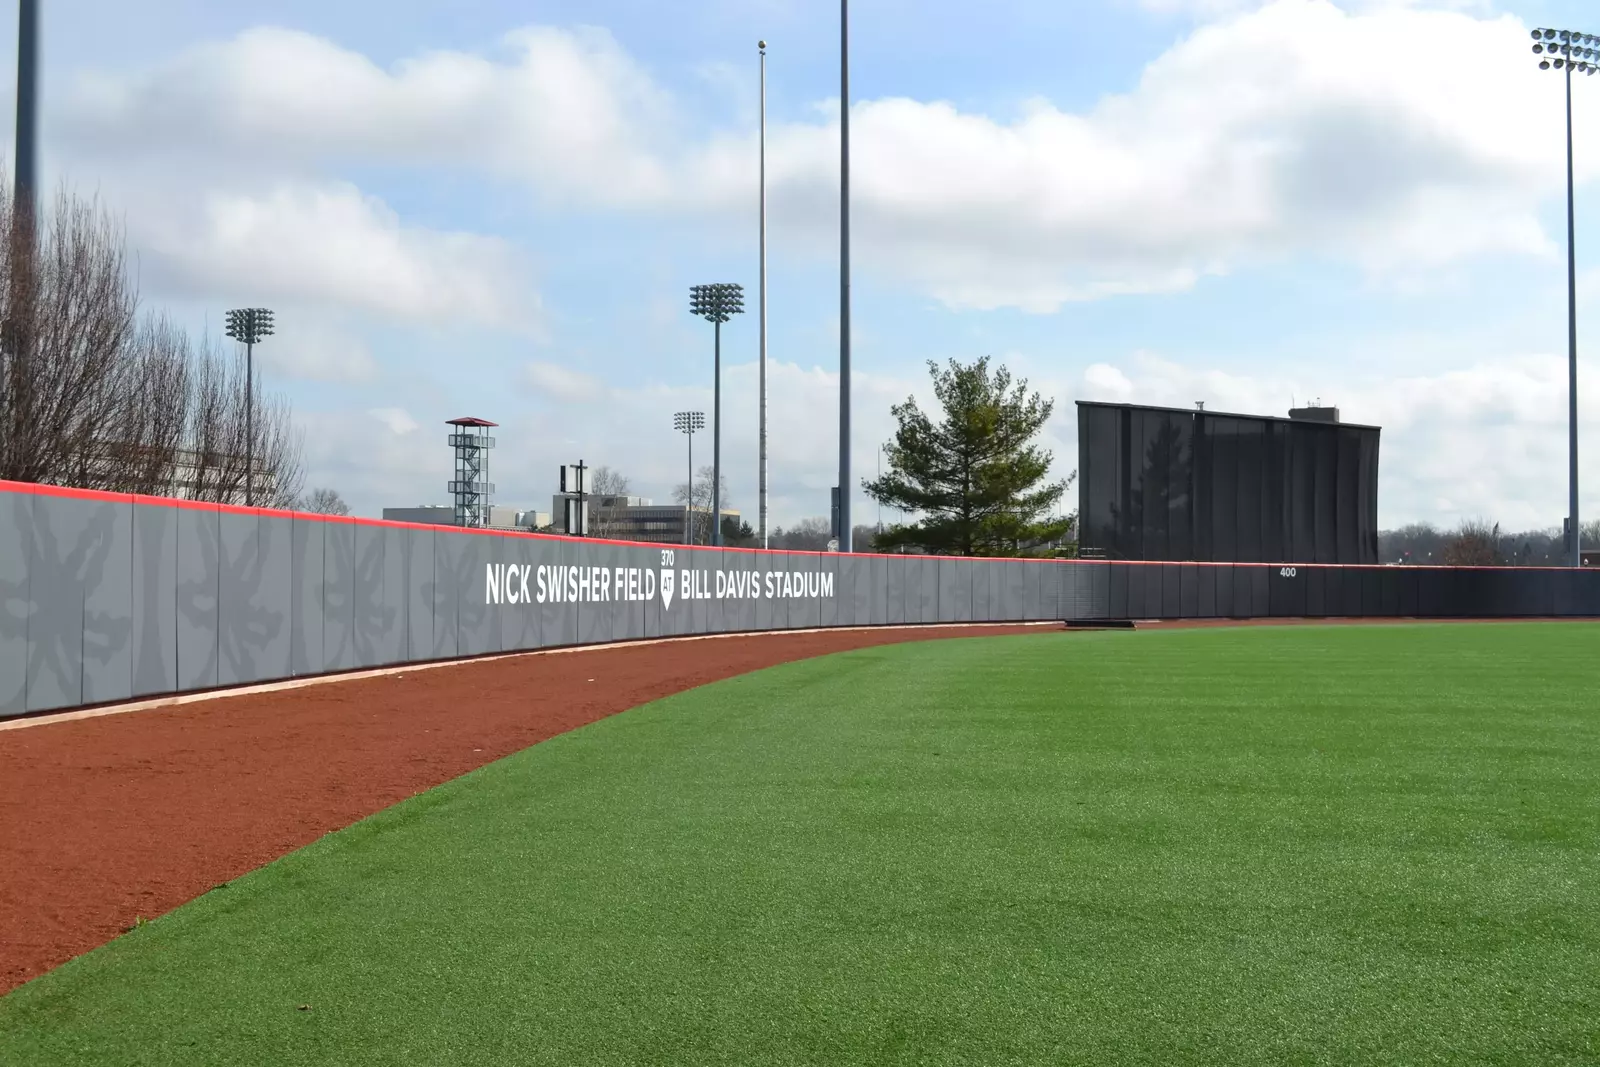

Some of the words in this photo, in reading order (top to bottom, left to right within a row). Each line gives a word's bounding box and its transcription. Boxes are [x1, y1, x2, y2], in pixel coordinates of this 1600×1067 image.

[661, 549, 675, 566] 370
[1280, 567, 1297, 577] 400
[485, 563, 532, 605] NICK
[536, 565, 610, 603] SWISHER
[614, 567, 656, 601] FIELD
[663, 576, 672, 592] AT
[681, 569, 711, 600] BILL
[716, 570, 760, 599] DAVIS
[765, 571, 834, 600] STADIUM
